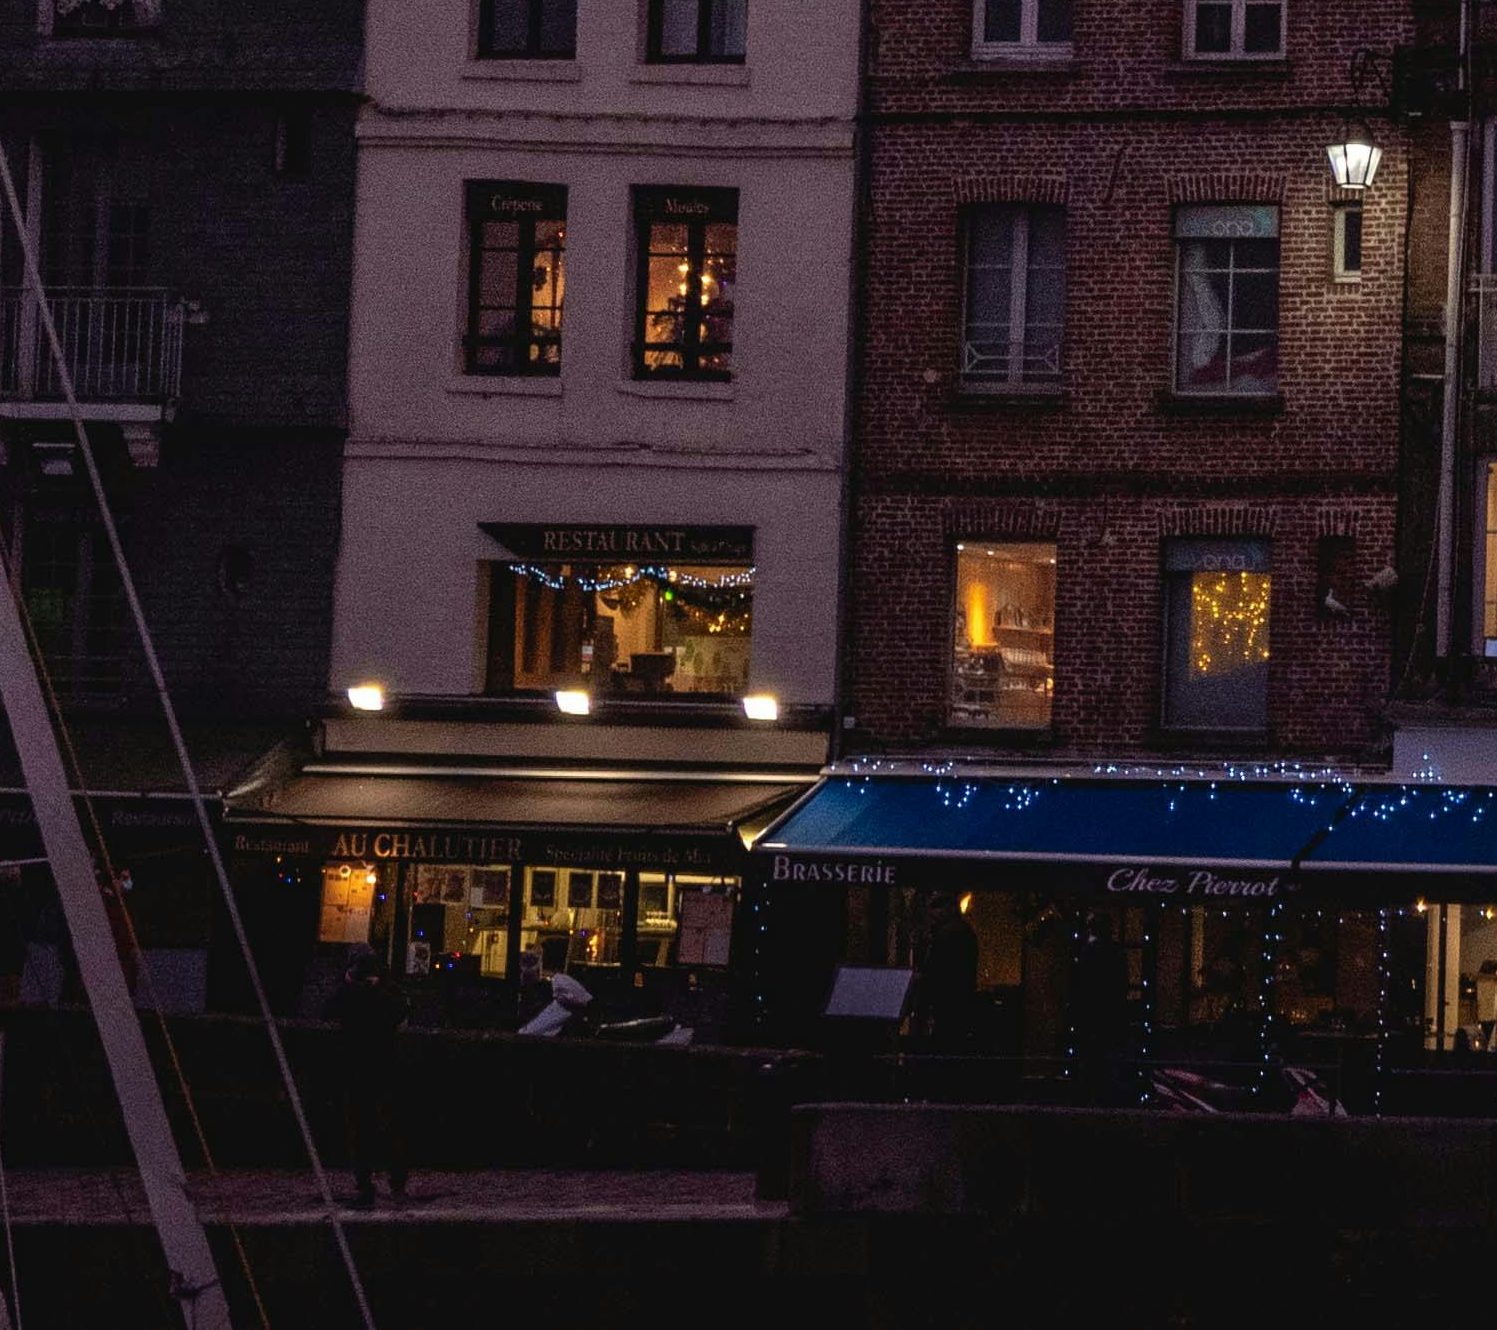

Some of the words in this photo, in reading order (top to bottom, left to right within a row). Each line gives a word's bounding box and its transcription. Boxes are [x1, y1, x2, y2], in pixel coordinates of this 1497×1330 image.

[543, 530, 686, 553] RESTAURANT
[332, 833, 369, 857] AU
[372, 833, 522, 862] CHALUTIER
[1106, 867, 1179, 893] Chez
[1185, 869, 1281, 897] Pierrot
